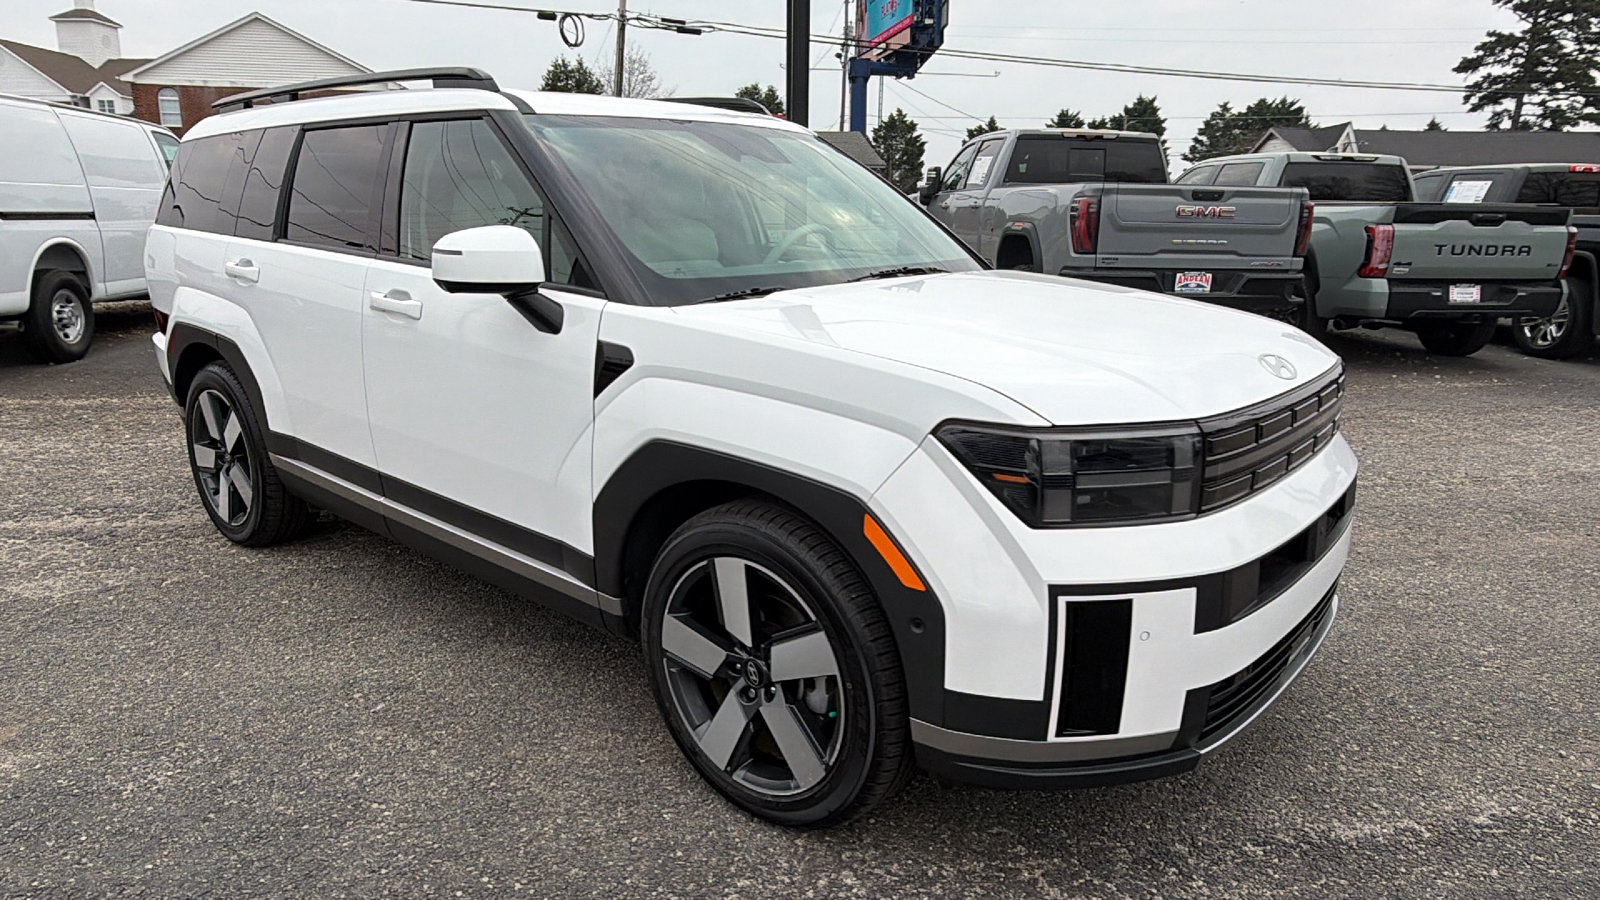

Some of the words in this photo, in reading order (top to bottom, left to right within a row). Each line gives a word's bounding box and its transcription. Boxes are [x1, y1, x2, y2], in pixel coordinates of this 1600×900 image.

[1176, 205, 1236, 219] GMC
[1434, 244, 1532, 257] TUNDRA
[1176, 274, 1211, 287] ANDEAN
